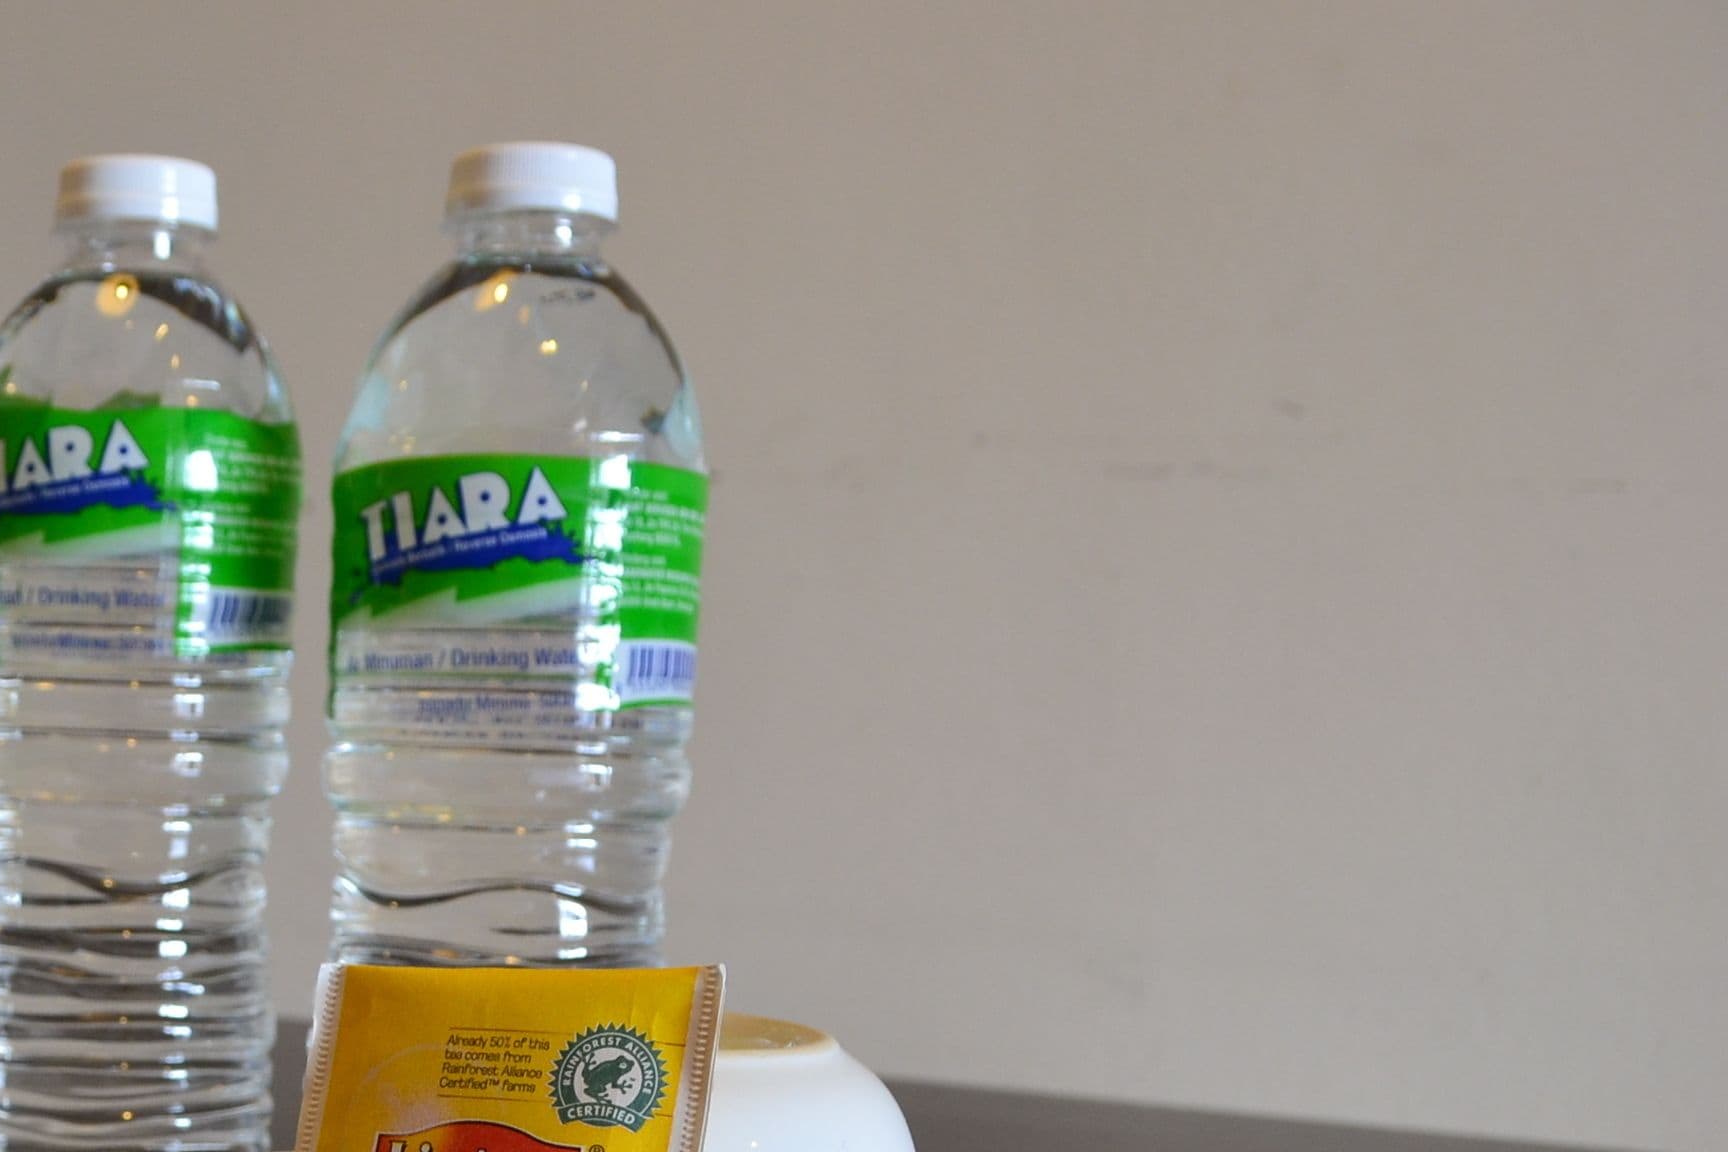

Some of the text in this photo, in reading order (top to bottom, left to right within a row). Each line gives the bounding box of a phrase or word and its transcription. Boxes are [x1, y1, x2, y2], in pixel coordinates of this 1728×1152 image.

[360, 464, 568, 560] TIARA
[451, 647, 529, 670] Drinking
[534, 647, 578, 667] Wate
[446, 1034, 551, 1050] Already 50% of this
[444, 1050, 532, 1063] tea comes from
[562, 1036, 655, 1095] RAINFOREST ALLIANCE
[441, 1063, 543, 1079] Rainforest Alliance
[501, 1080, 536, 1093] farms
[567, 1105, 636, 1126] CERTIFIED
